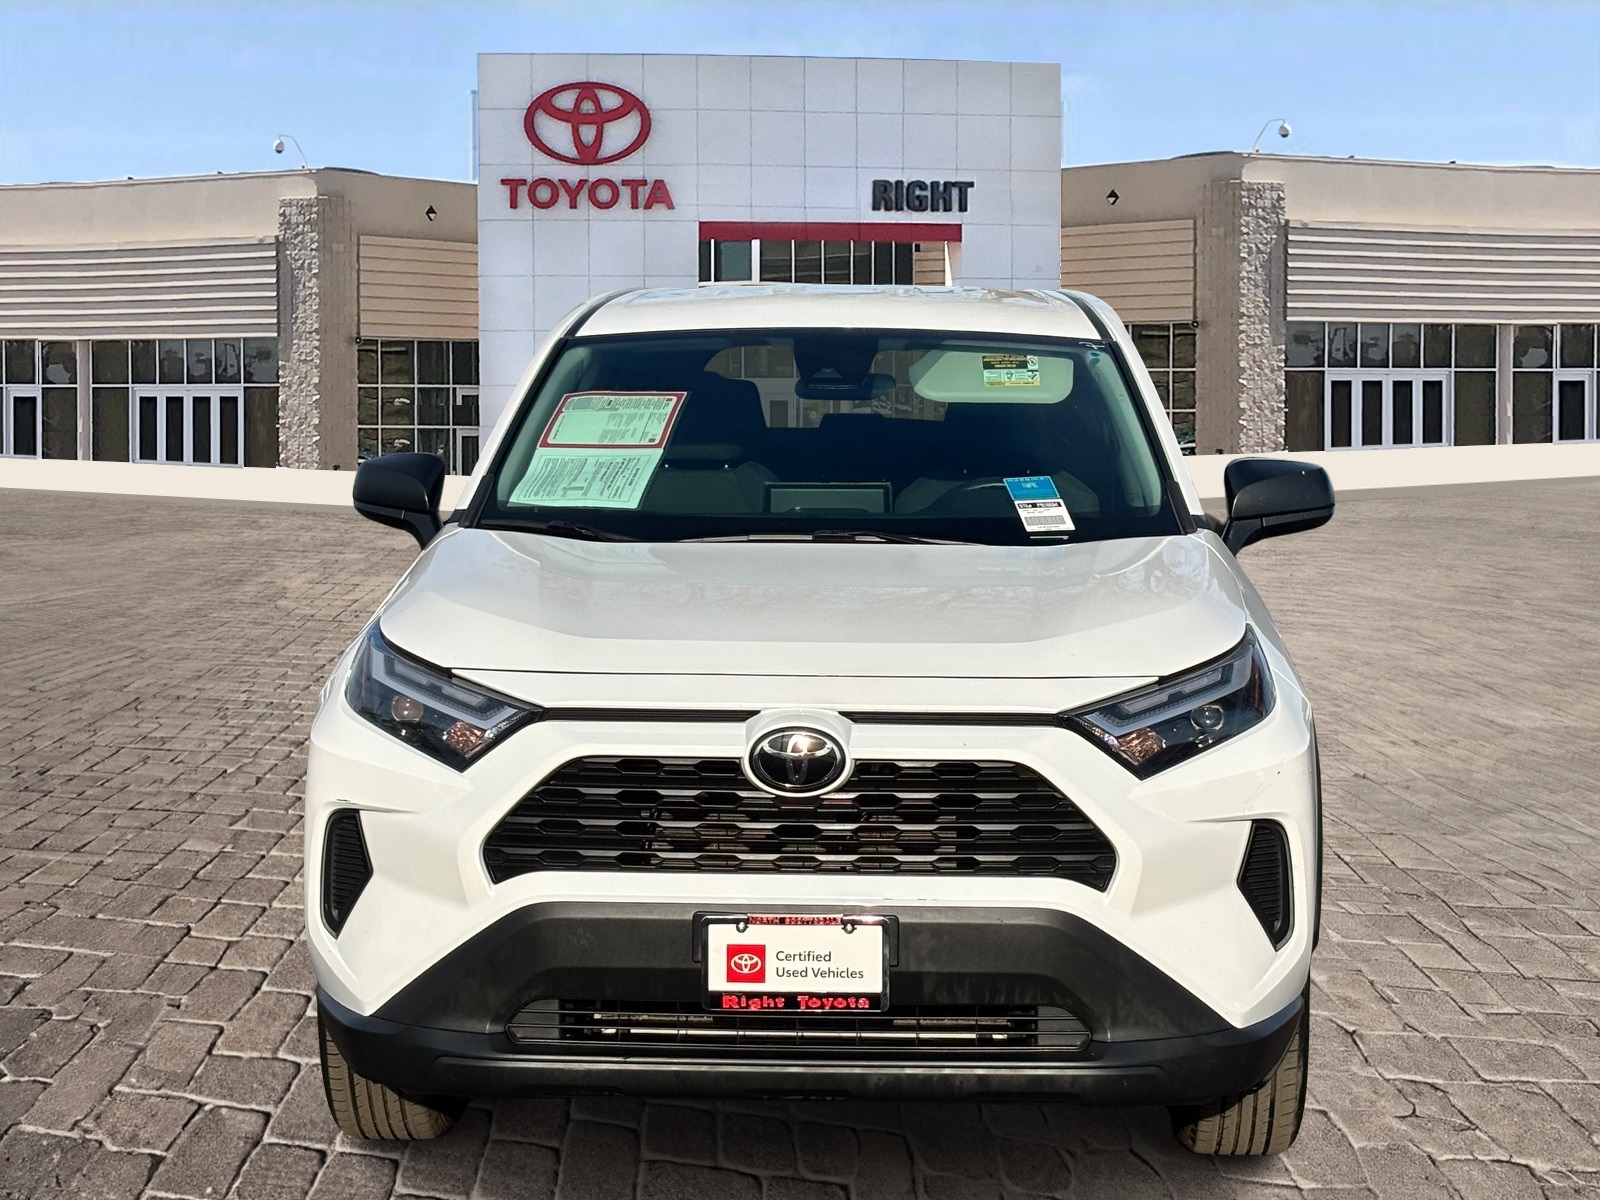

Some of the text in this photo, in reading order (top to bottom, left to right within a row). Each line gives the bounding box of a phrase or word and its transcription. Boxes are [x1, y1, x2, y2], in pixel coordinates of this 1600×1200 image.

[500, 178, 675, 210] TOYOTA
[871, 180, 975, 213] RIGHT
[775, 950, 832, 962] Certified
[775, 967, 864, 979] Used Vehicles
[722, 995, 870, 1010] Right Toyota
